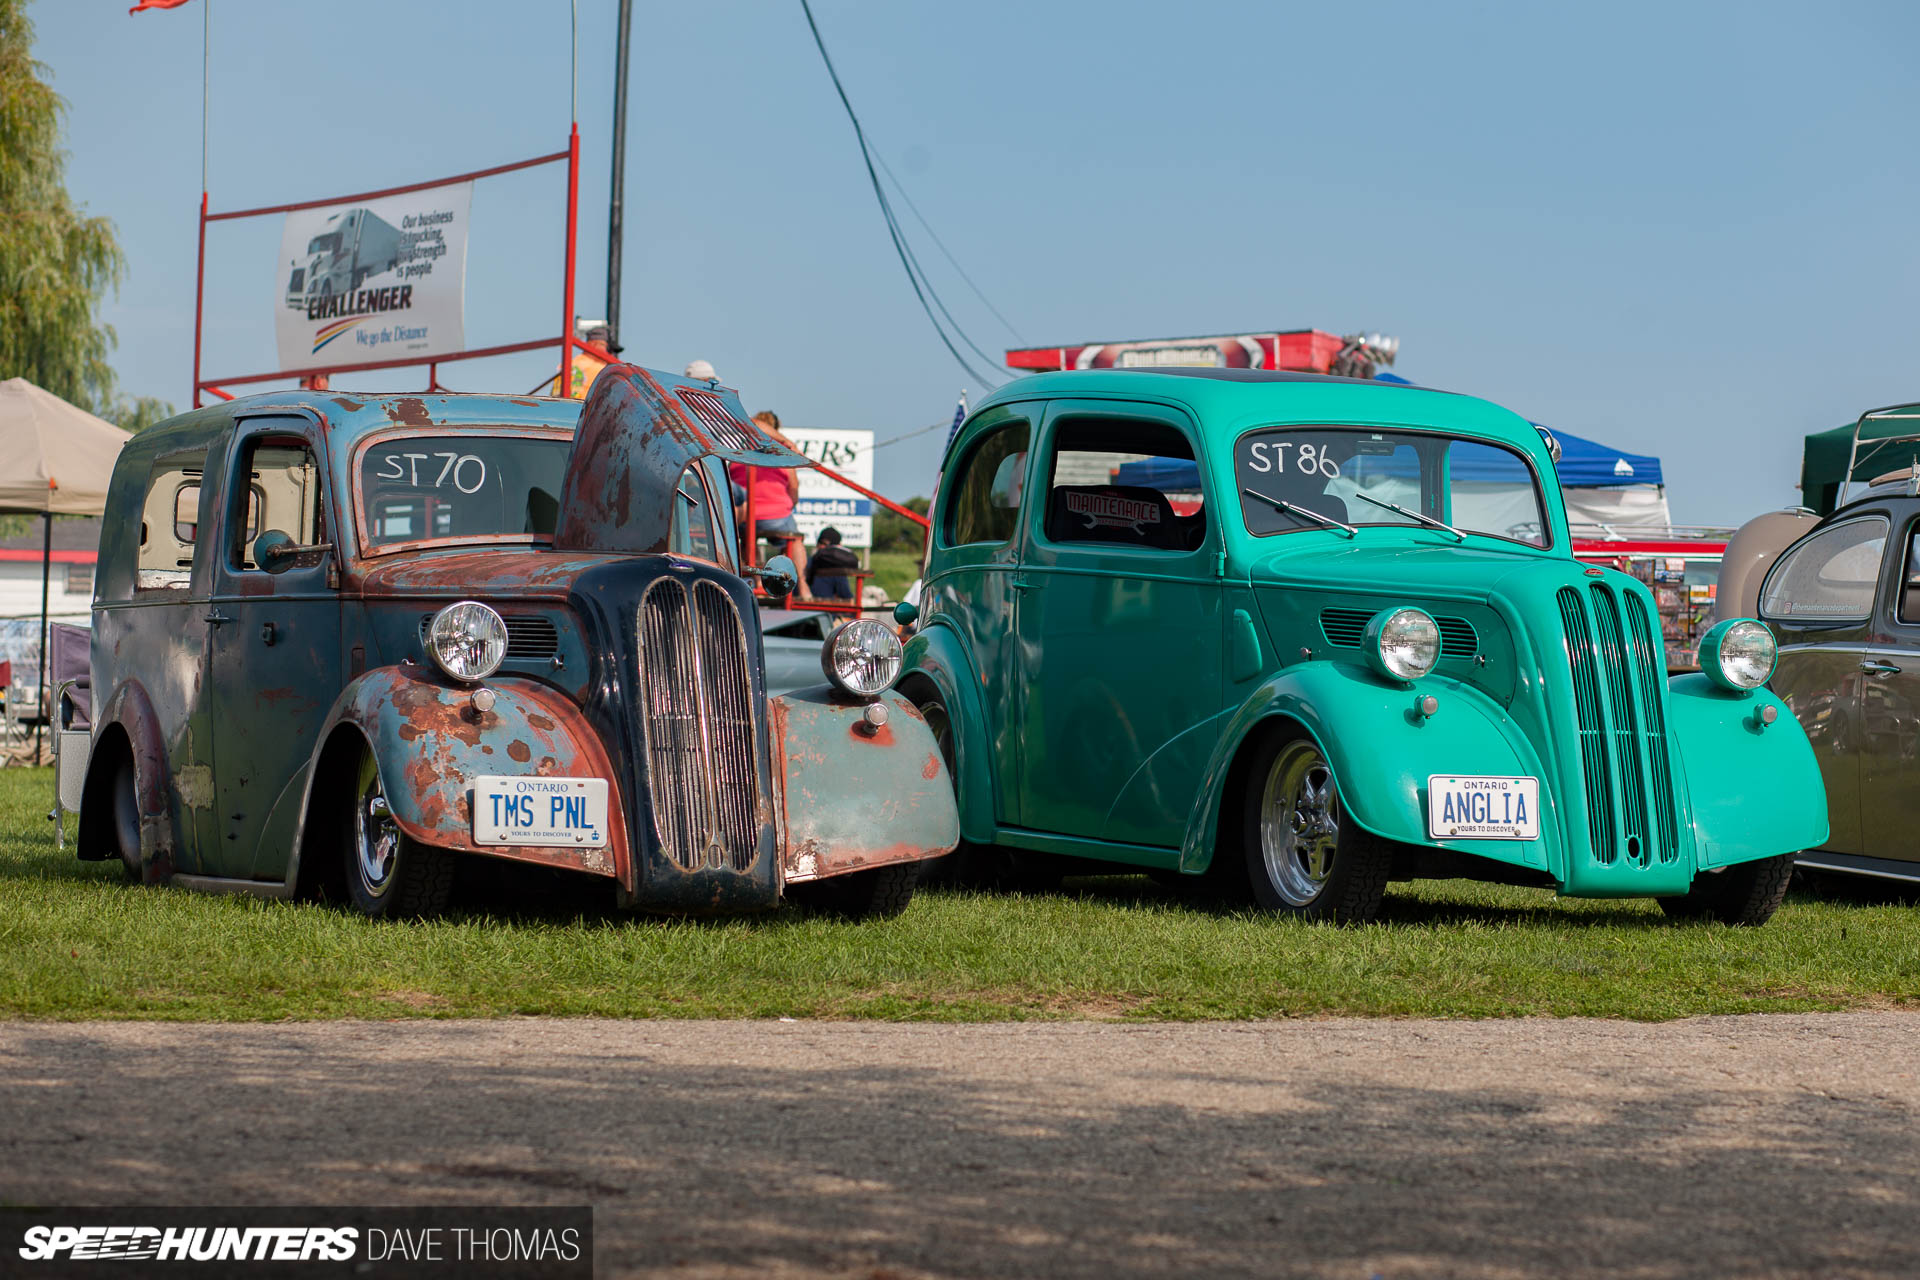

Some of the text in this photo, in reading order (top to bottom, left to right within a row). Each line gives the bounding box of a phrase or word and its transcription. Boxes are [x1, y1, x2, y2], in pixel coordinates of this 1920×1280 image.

[402, 210, 454, 229] Our business
[413, 242, 446, 260] strength
[397, 260, 432, 280] is people
[308, 285, 413, 321] CHALLENGER
[356, 326, 428, 348] We go the Distance
[796, 440, 859, 467] ERS
[1249, 443, 1341, 479] ST 86
[377, 453, 486, 494] ST 70
[1068, 493, 1158, 521] MAINTENANCE
[516, 782, 568, 793] ONTARIO
[1464, 781, 1508, 790] ONTARIO
[490, 794, 594, 828] TMS PNL
[1443, 792, 1527, 824] ANGLIA
